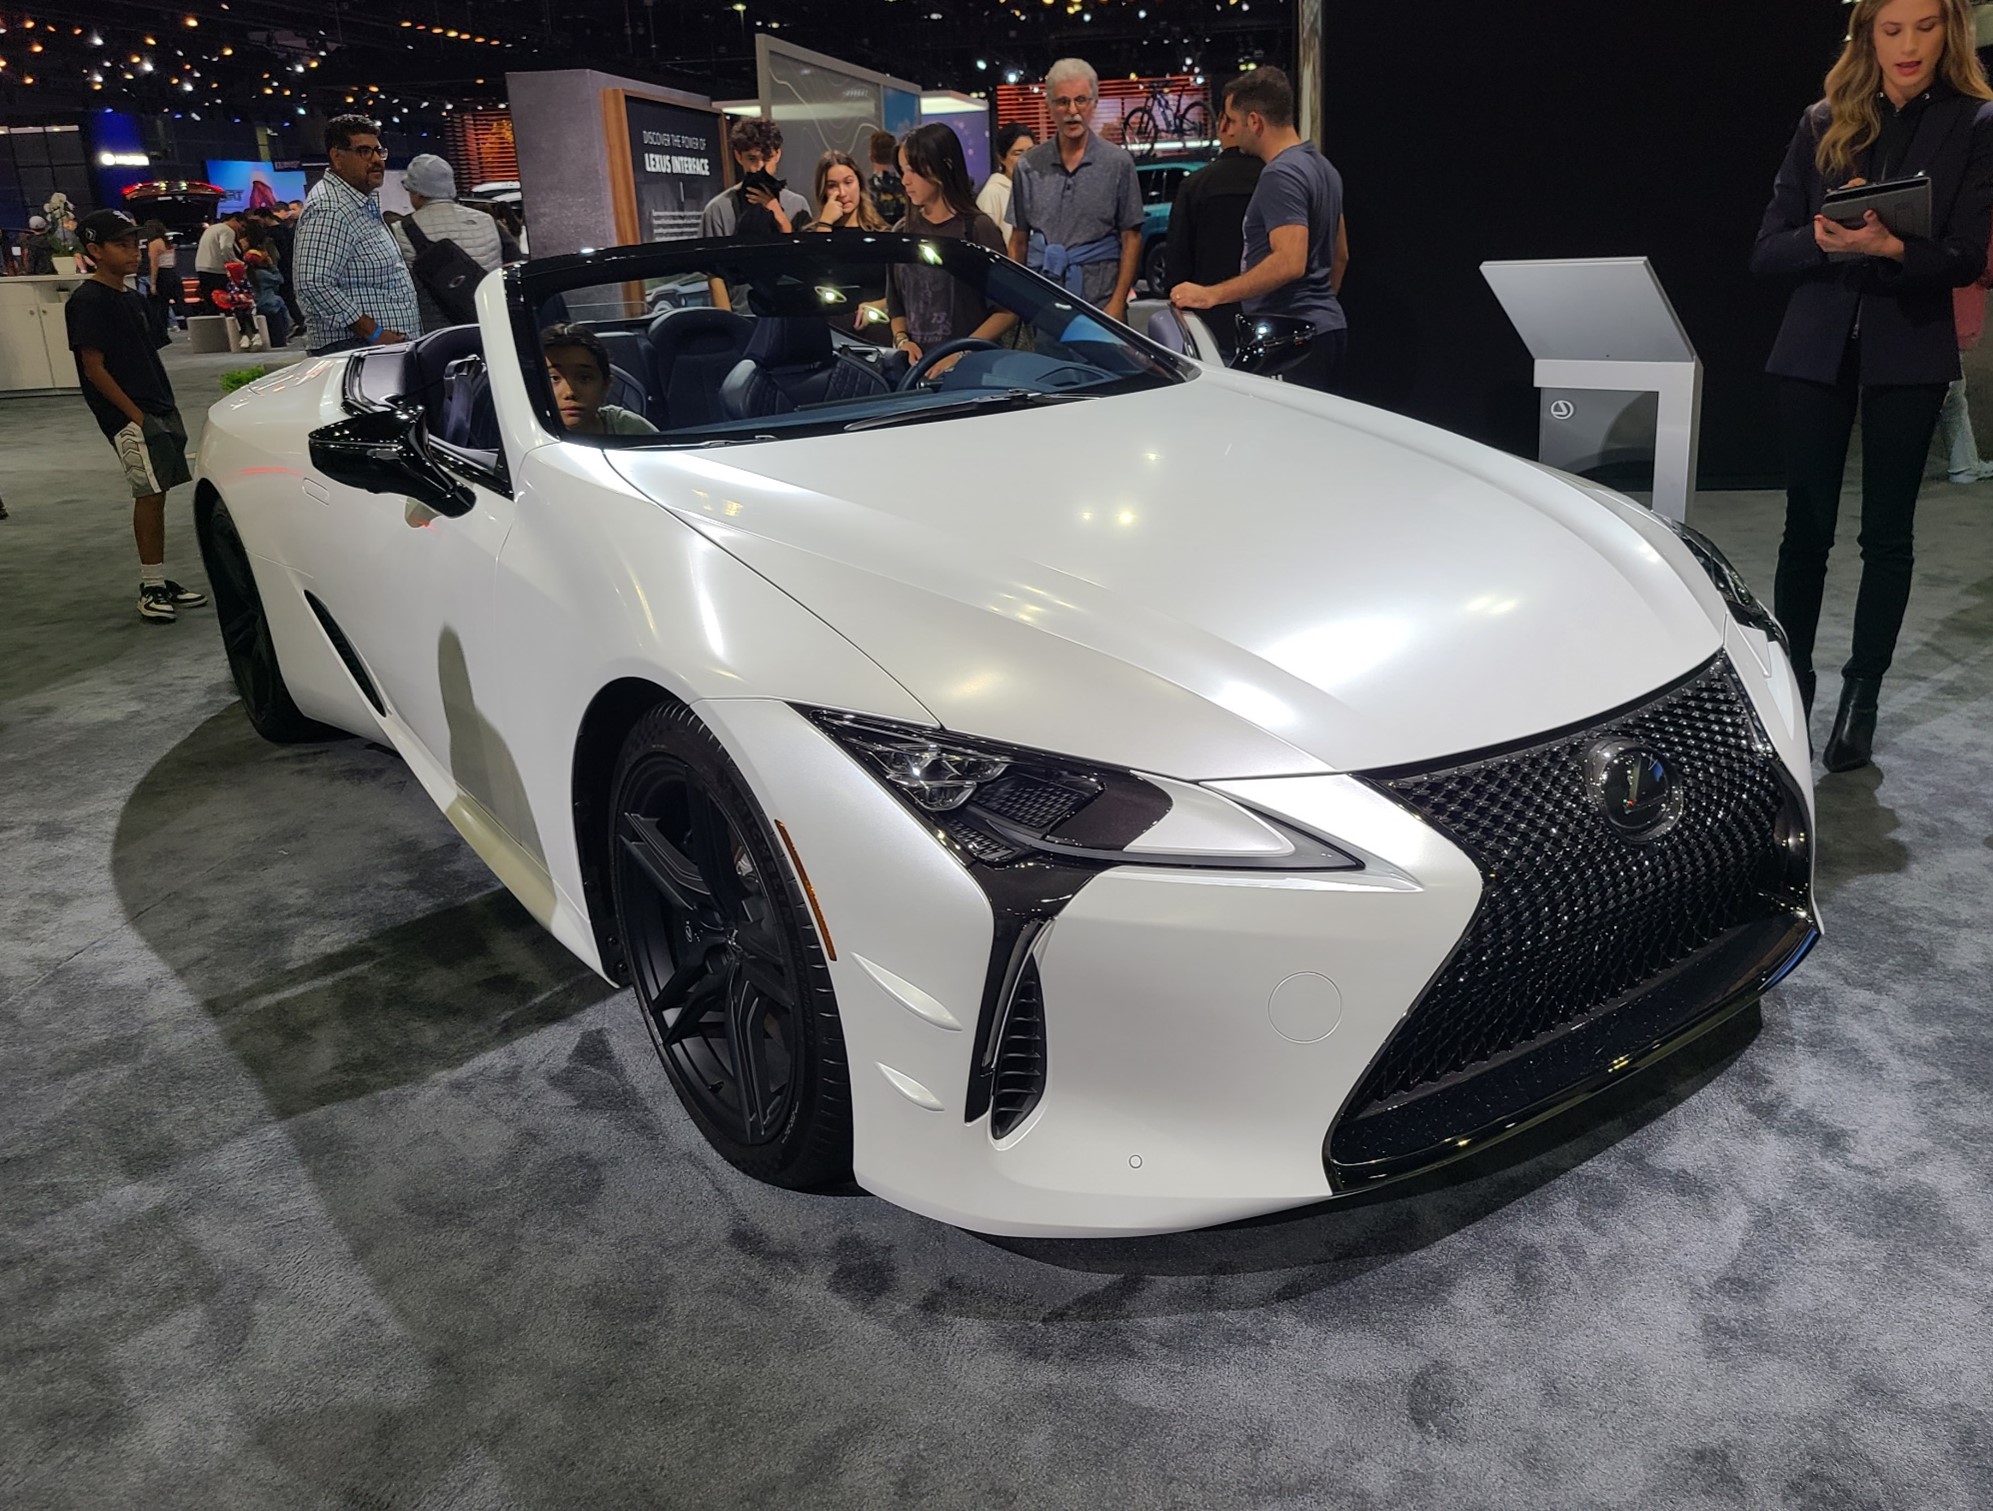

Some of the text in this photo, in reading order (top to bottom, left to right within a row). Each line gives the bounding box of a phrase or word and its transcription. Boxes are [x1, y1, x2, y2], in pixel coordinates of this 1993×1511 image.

[642, 130, 707, 151] DISCOVER THE POWER OF
[644, 153, 711, 176] LEXUS INTERFACE
